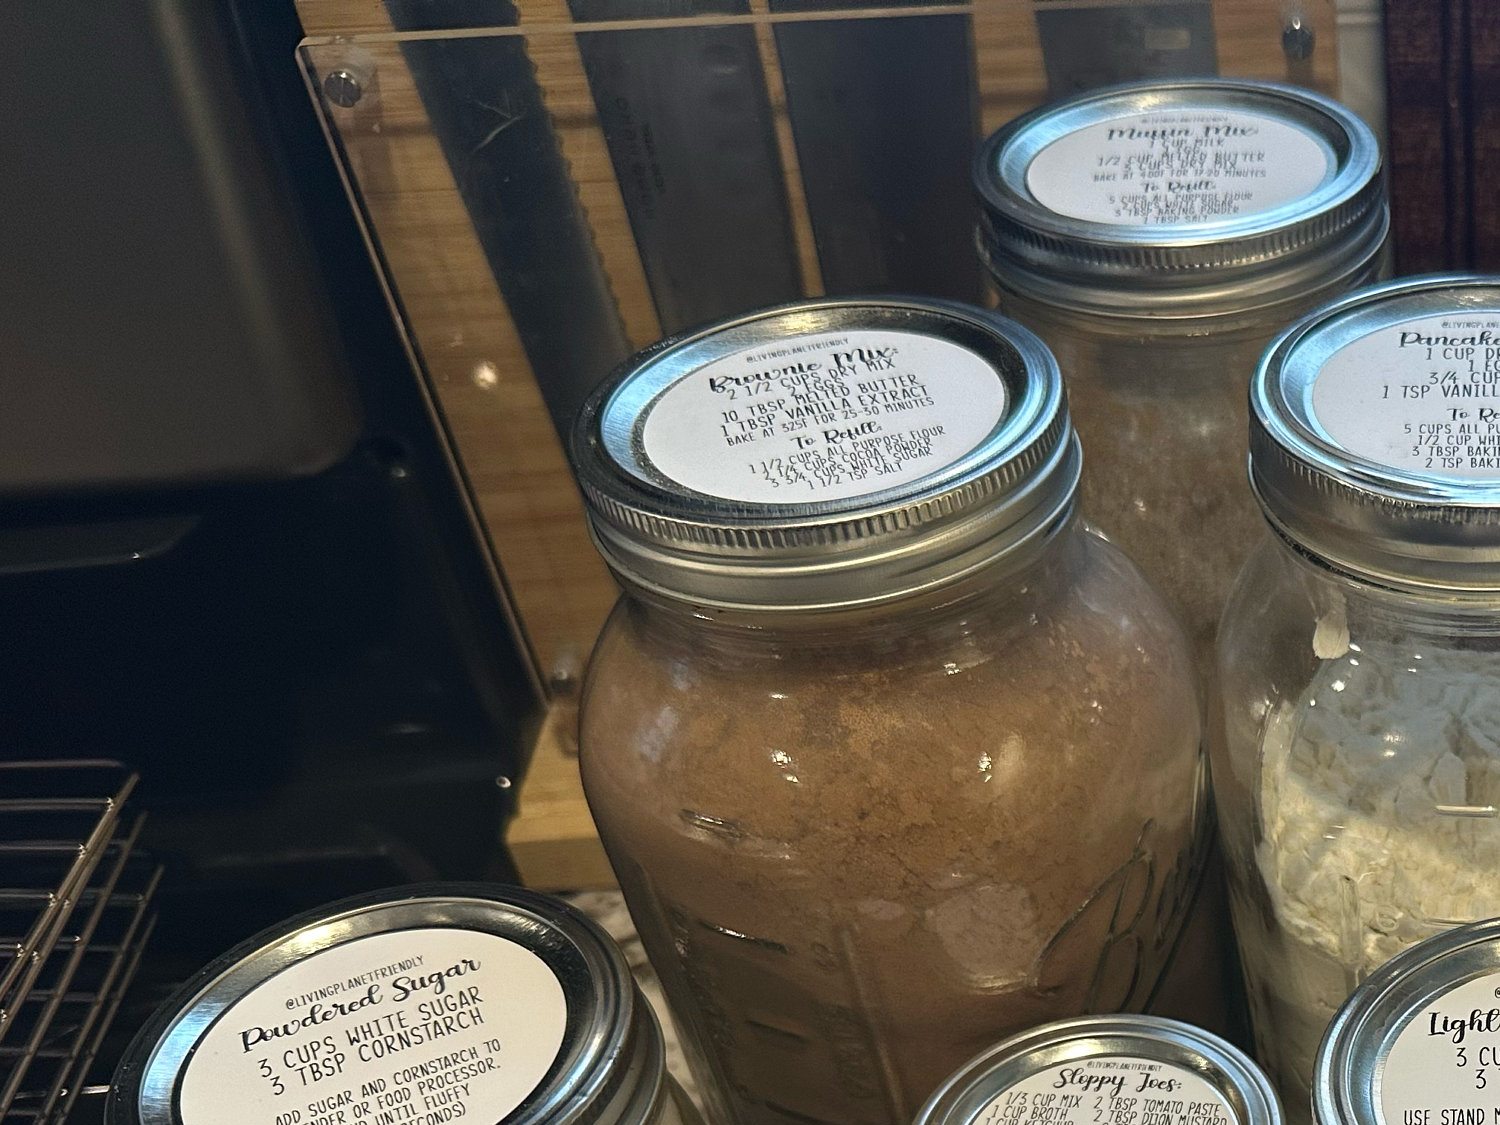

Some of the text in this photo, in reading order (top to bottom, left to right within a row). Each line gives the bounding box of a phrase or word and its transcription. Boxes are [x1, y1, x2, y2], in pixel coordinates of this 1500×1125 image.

[1425, 348, 1432, 360] 1
[1443, 348, 1474, 360] CUP
[1468, 360, 1475, 371] 1
[709, 346, 898, 394] Brownie Mix:
[727, 357, 896, 400] 2 1/2 CUPS DRY MIX
[789, 377, 845, 397] 2 EGGS
[286, 955, 424, 1010] @LIVINGPLANETFRIENDLY
[238, 959, 481, 1053] Powdered Sugar
[258, 986, 484, 1077] 3 CUPS WHITE SUGAR
[272, 1008, 484, 1096] 3 TBSP CORNSTARCH
[1457, 1047, 1468, 1066] 3
[1053, 1069, 1182, 1096] Sloppy Joes:
[1475, 1068, 1487, 1089] 3
[991, 1105, 1067, 1121] 1 CUP BROTH
